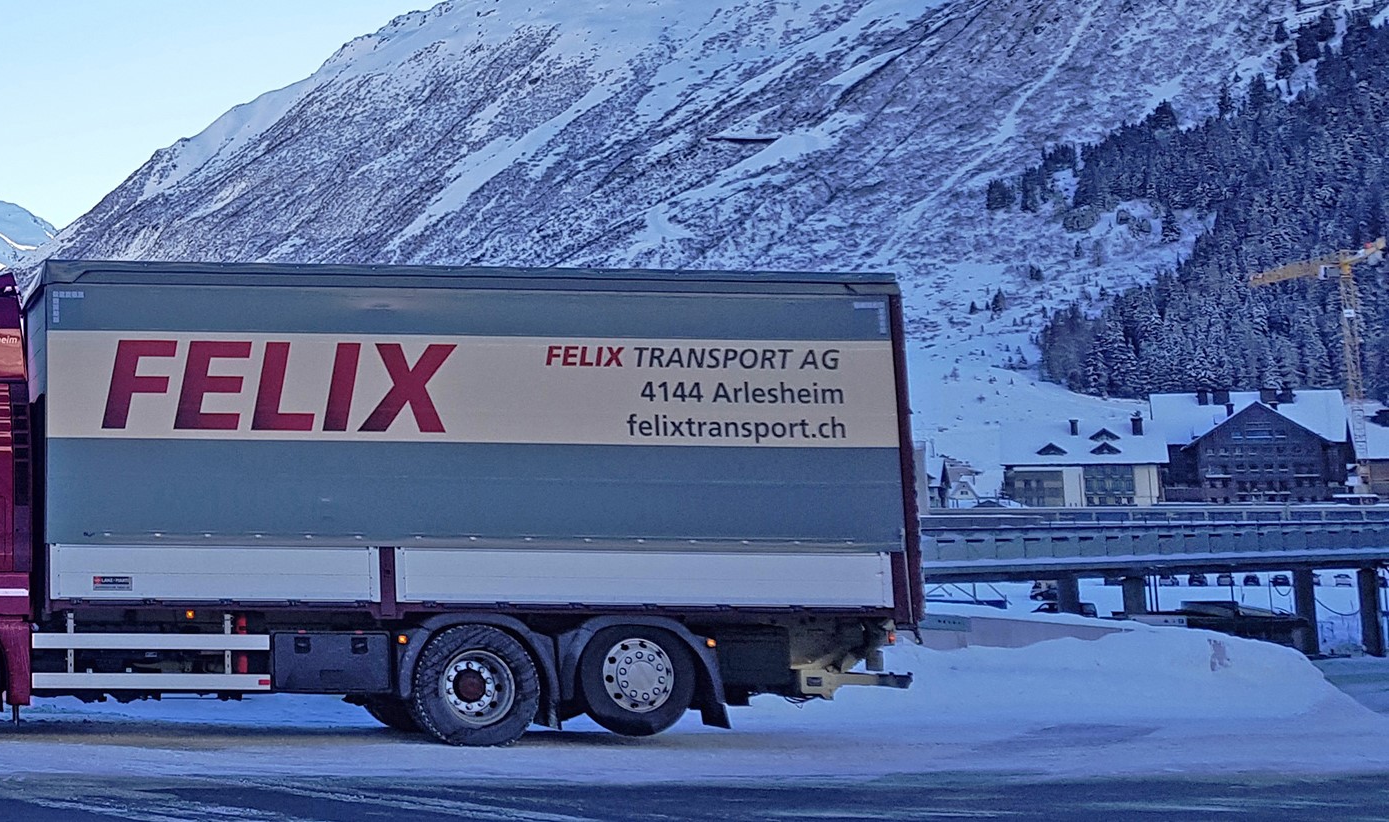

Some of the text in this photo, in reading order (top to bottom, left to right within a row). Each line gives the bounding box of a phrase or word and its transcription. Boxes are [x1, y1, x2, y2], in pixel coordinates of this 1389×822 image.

[544, 345, 841, 370] FELIX TRANSPORT AG
[101, 339, 458, 433] FELIX
[640, 381, 845, 404] 4144 Arlesheim
[627, 413, 847, 443] felixtransport.ch
